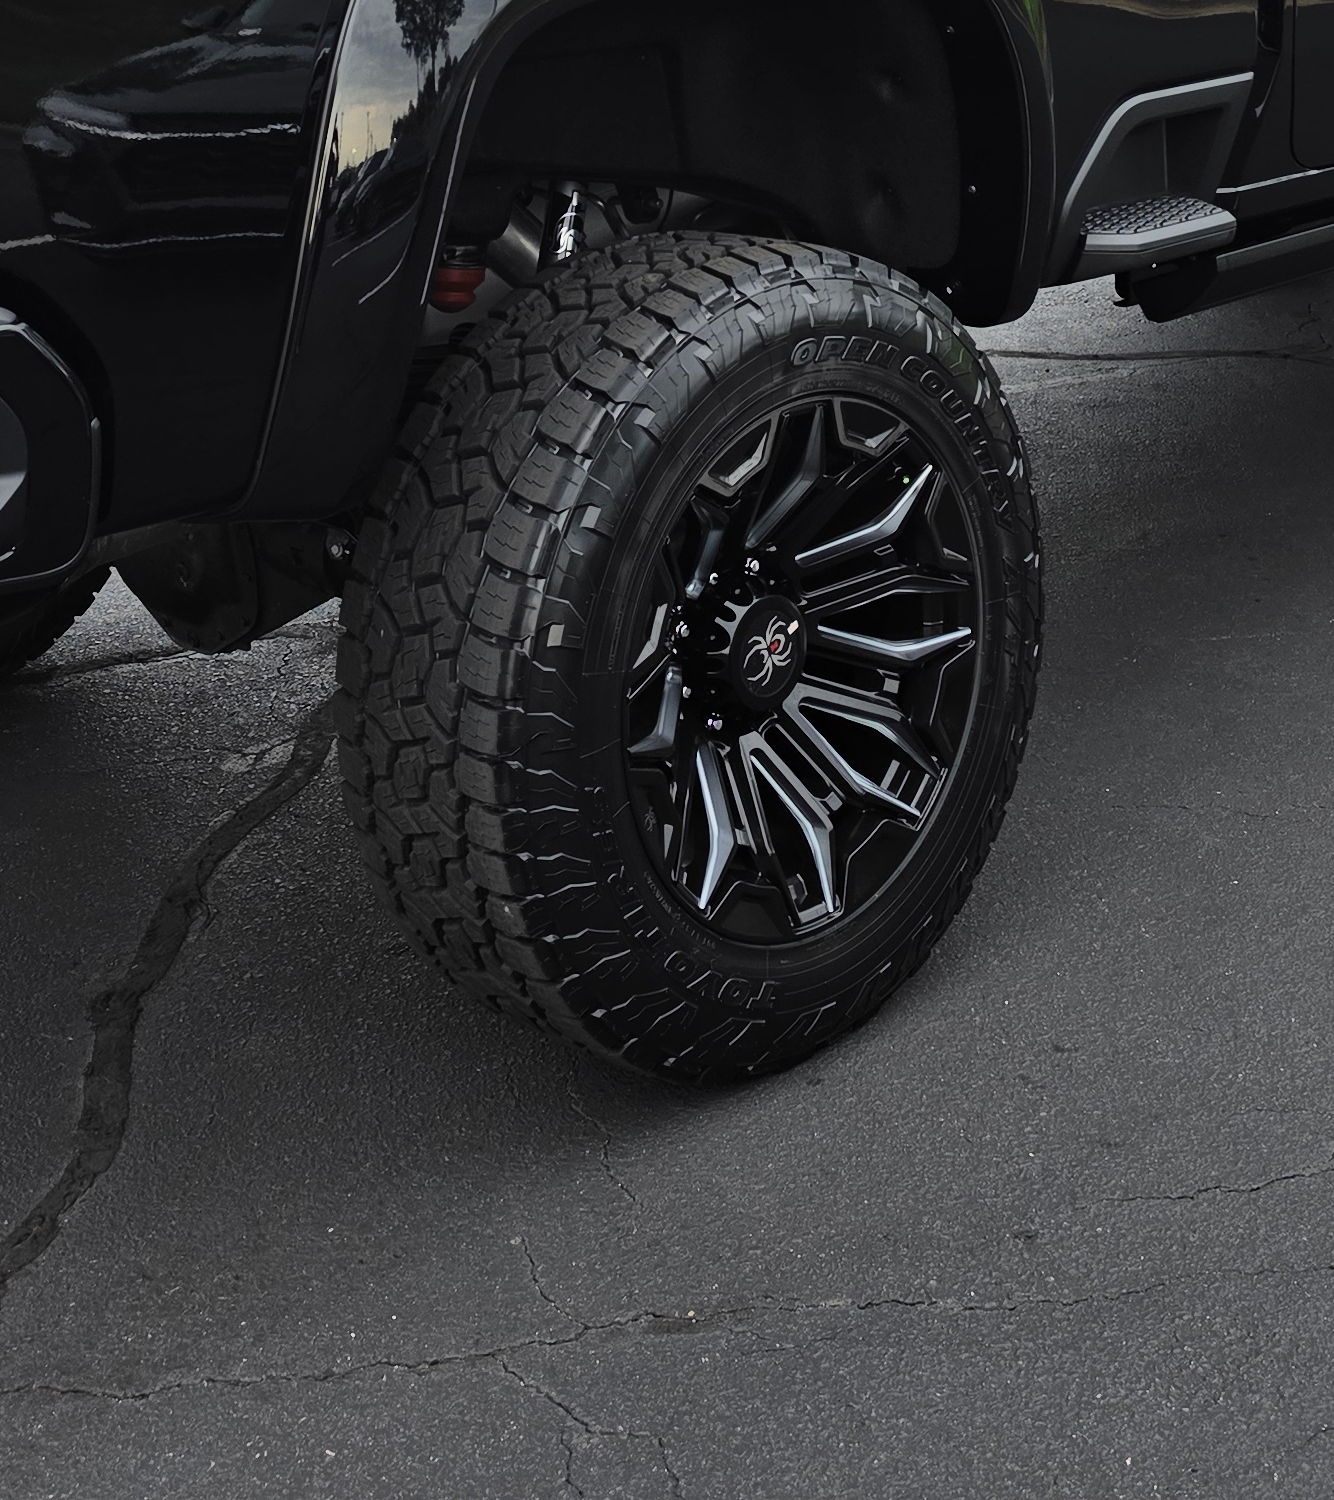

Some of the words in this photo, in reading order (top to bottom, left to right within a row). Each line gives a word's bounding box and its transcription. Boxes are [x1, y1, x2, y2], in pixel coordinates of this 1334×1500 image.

[790, 334, 900, 370] OPEN
[899, 355, 1015, 535] COUNTRY
[663, 950, 779, 1010] TOYO
